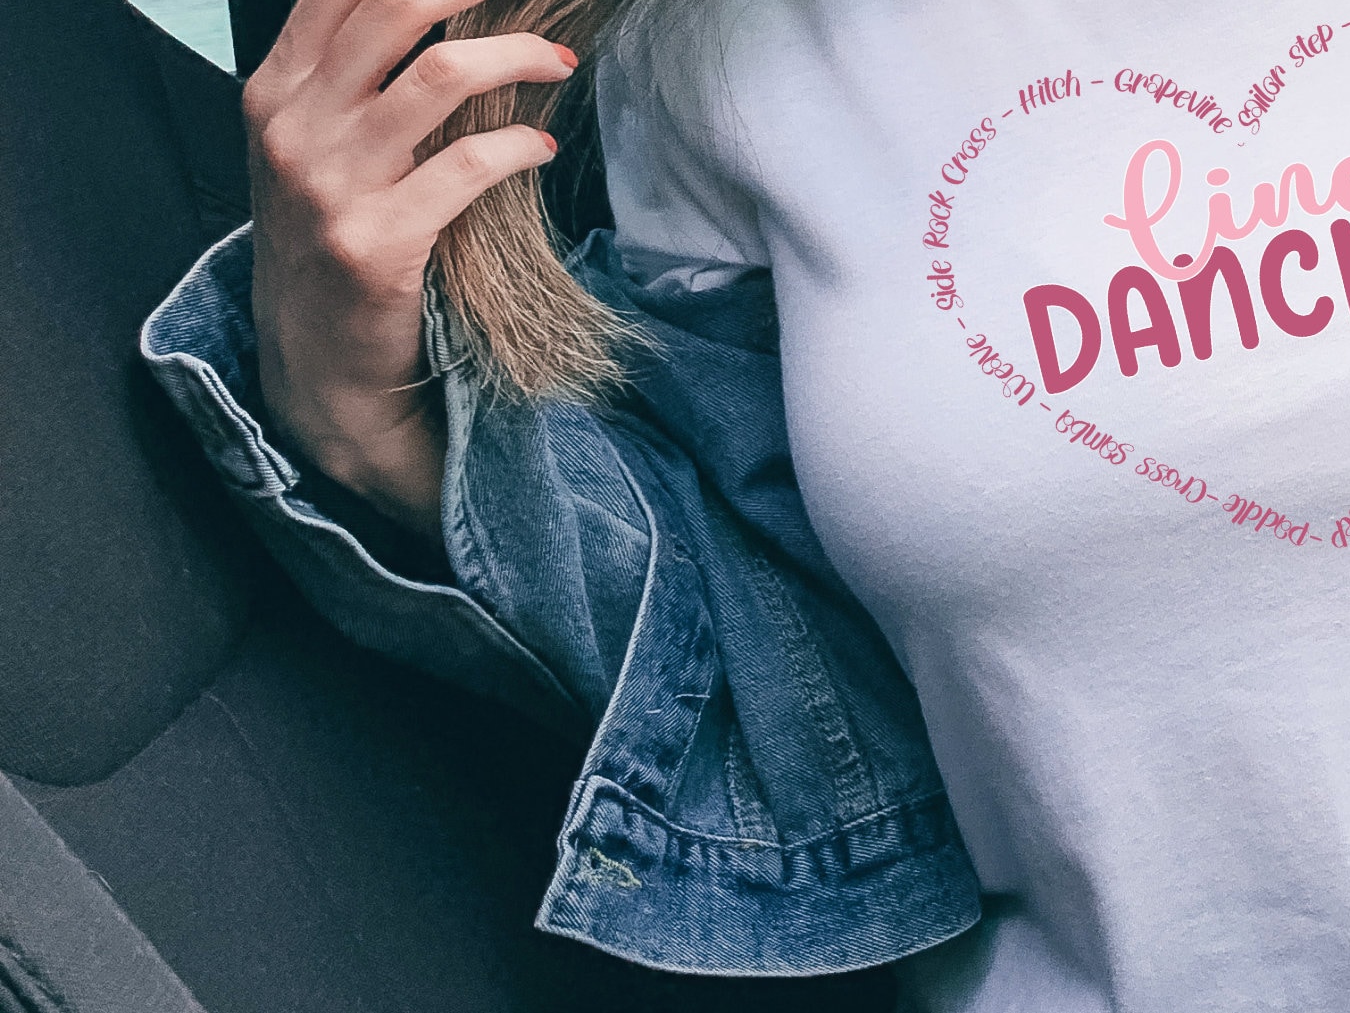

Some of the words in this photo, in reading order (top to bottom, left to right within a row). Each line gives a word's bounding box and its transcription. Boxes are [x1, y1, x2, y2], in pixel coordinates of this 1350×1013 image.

[1288, 24, 1334, 68] step
[1017, 68, 1082, 116] Hitch
[1113, 67, 1234, 135] Grapevine
[940, 117, 998, 186] Cross
[922, 189, 956, 250] Rock
[965, 333, 1036, 406] Weave
